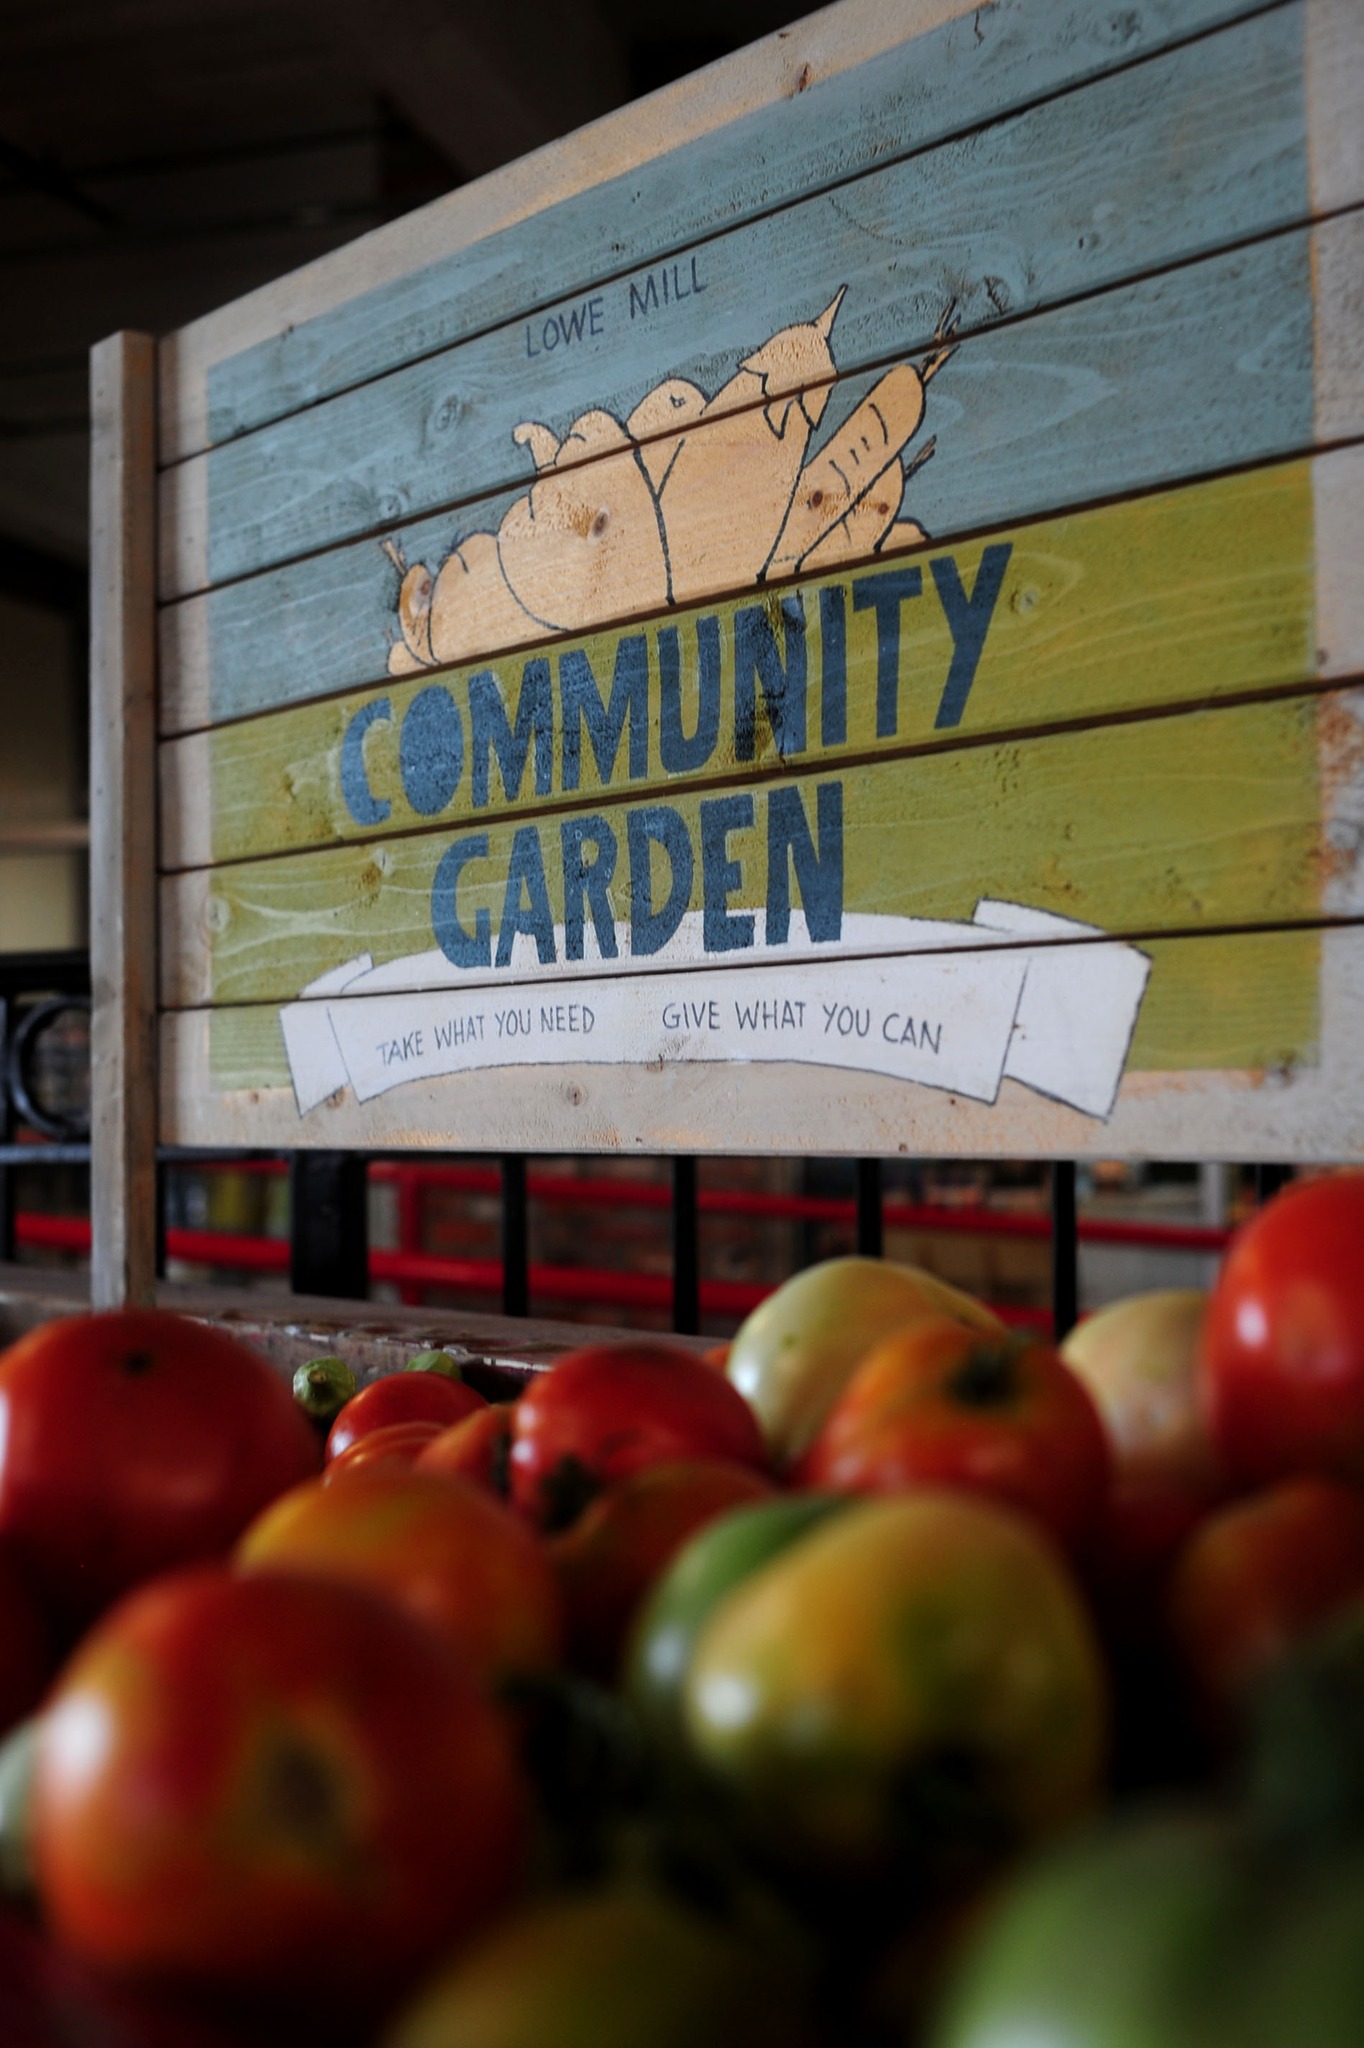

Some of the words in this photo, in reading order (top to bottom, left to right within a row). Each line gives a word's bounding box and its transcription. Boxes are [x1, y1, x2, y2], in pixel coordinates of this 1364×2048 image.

[526, 297, 604, 358] LOWE
[629, 256, 707, 319] MILL
[341, 543, 1012, 826] COMMUNITY
[431, 781, 844, 968] GARDEN
[376, 1030, 424, 1065] TAKE
[434, 1015, 485, 1050] WHAT
[495, 1008, 531, 1037] YOU
[540, 1004, 595, 1034] NEED
[662, 1000, 721, 1030] GIVE
[735, 1000, 806, 1030] WHAT
[823, 1002, 871, 1037] YOU
[882, 1013, 942, 1054] CAN
